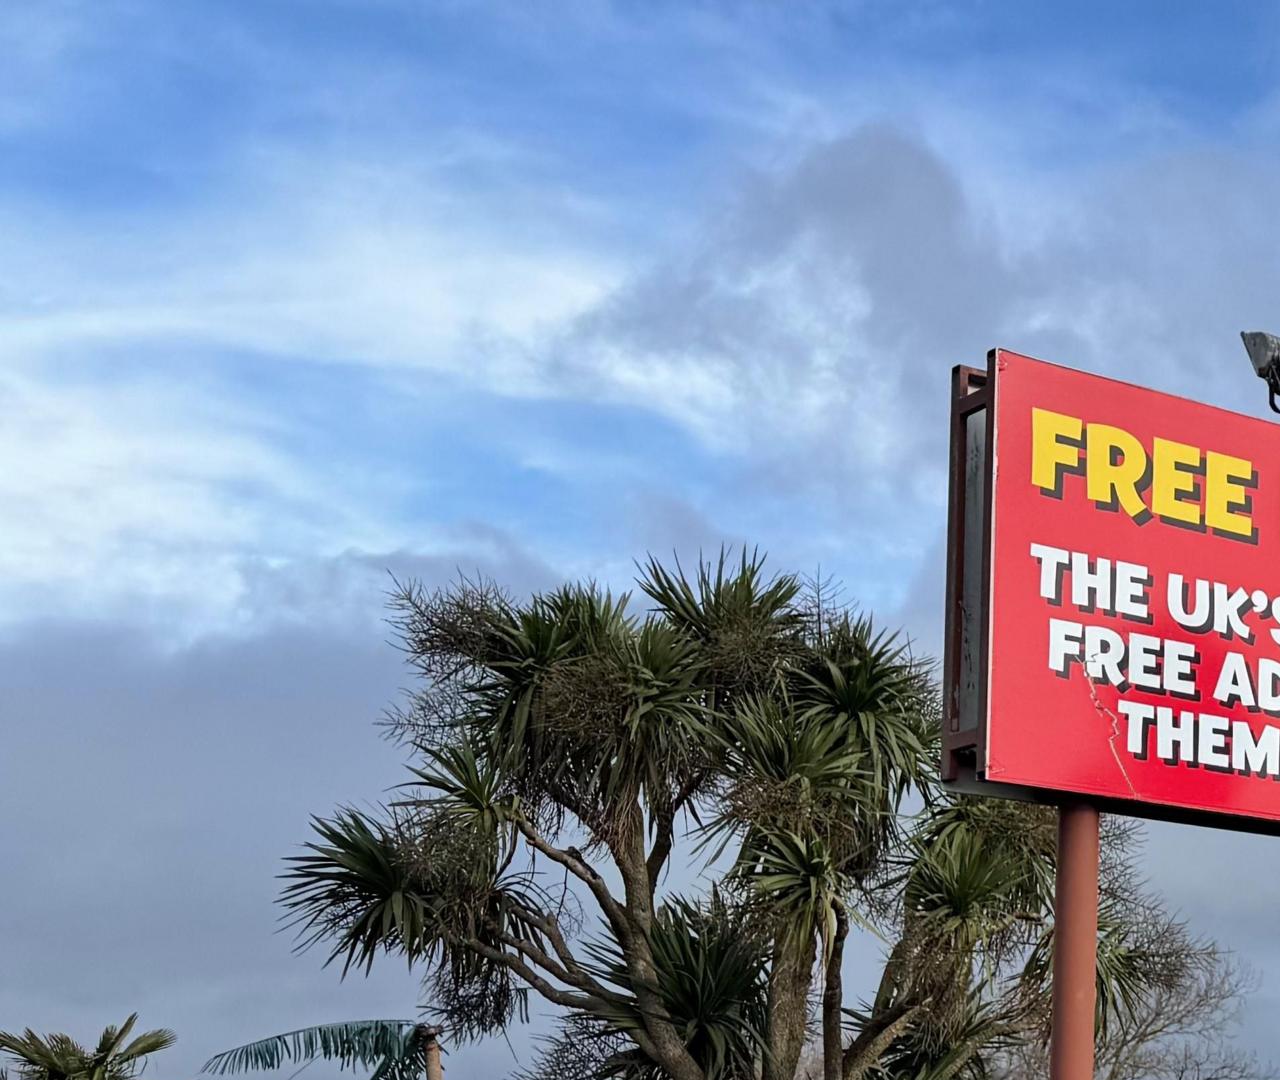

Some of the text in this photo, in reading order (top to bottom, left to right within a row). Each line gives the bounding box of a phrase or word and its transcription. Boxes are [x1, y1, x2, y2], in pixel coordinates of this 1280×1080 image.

[1030, 407, 1256, 539] FREE
[1030, 542, 1150, 616] THE
[1048, 618, 1199, 693] FREE
